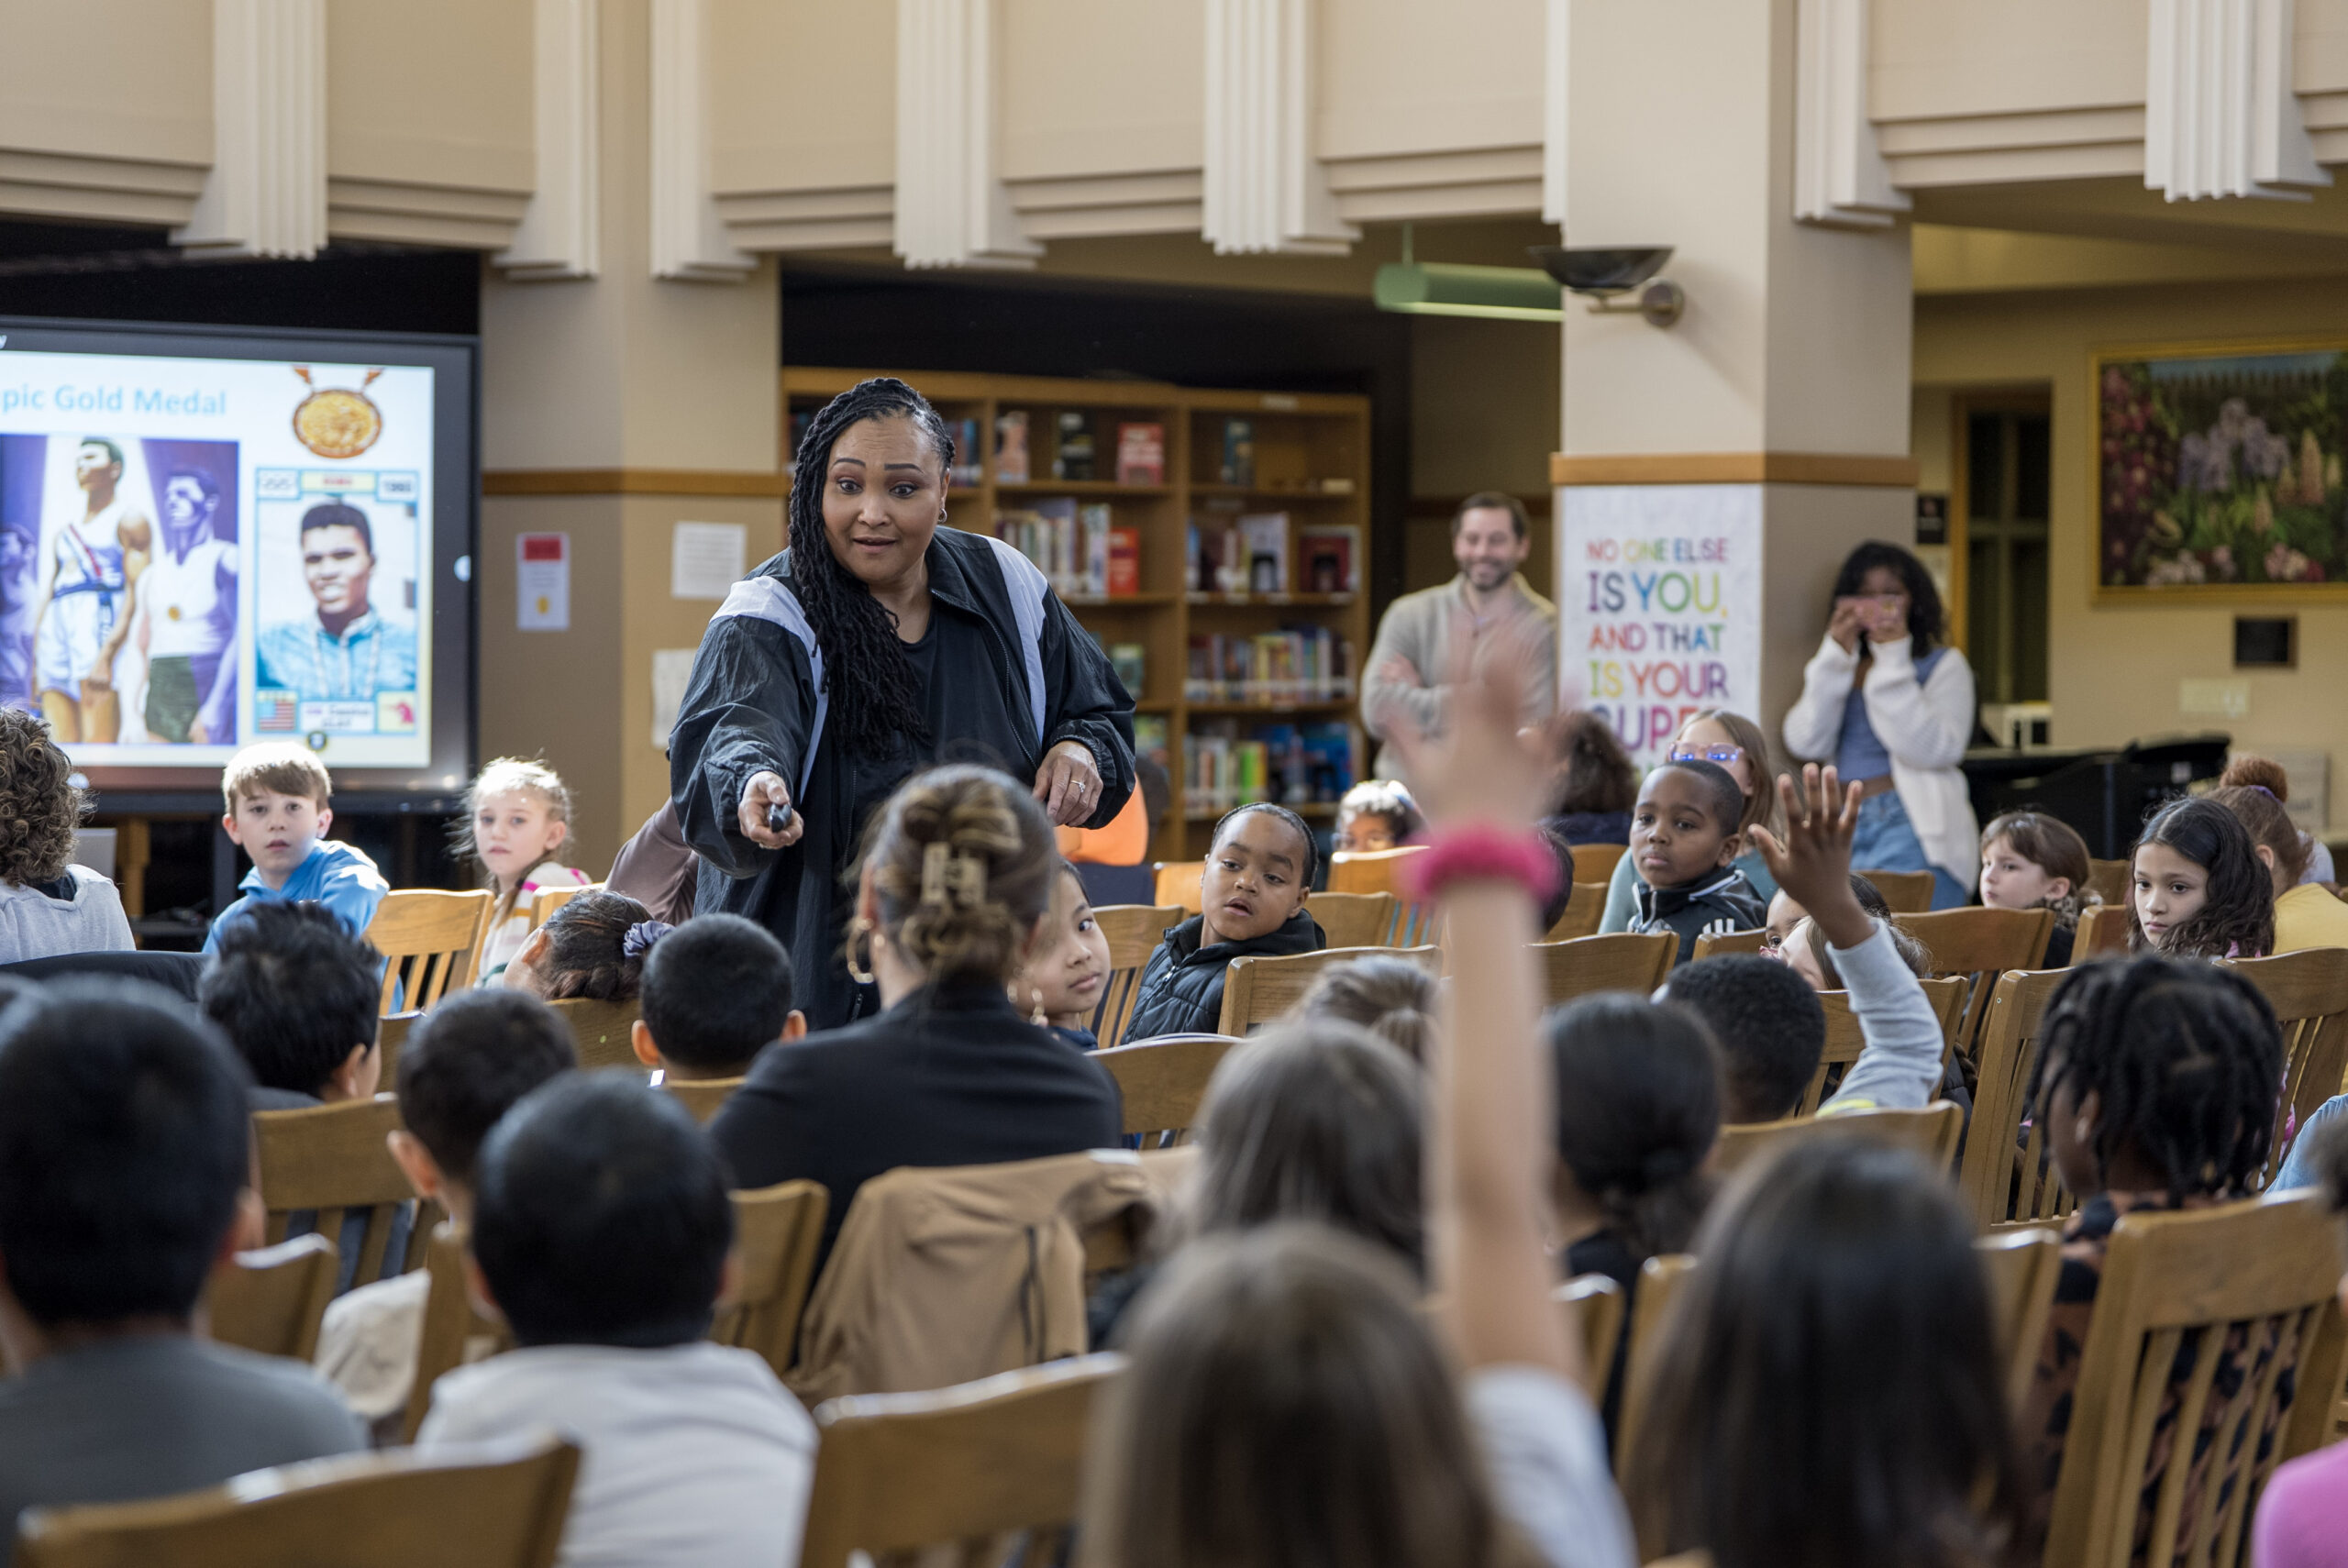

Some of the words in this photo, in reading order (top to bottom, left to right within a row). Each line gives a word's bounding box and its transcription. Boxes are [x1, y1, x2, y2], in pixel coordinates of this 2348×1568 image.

[54, 384, 123, 412] Gold
[134, 387, 227, 414] Medal
[1586, 537, 1618, 561] NO
[1623, 537, 1668, 562] ONE
[1674, 536, 1729, 562] ELSE
[1588, 570, 1625, 613] IS
[1589, 623, 1647, 653] AND
[1654, 624, 1725, 652] THAT
[1589, 660, 1623, 699] IS
[1628, 660, 1730, 700] YOUR
